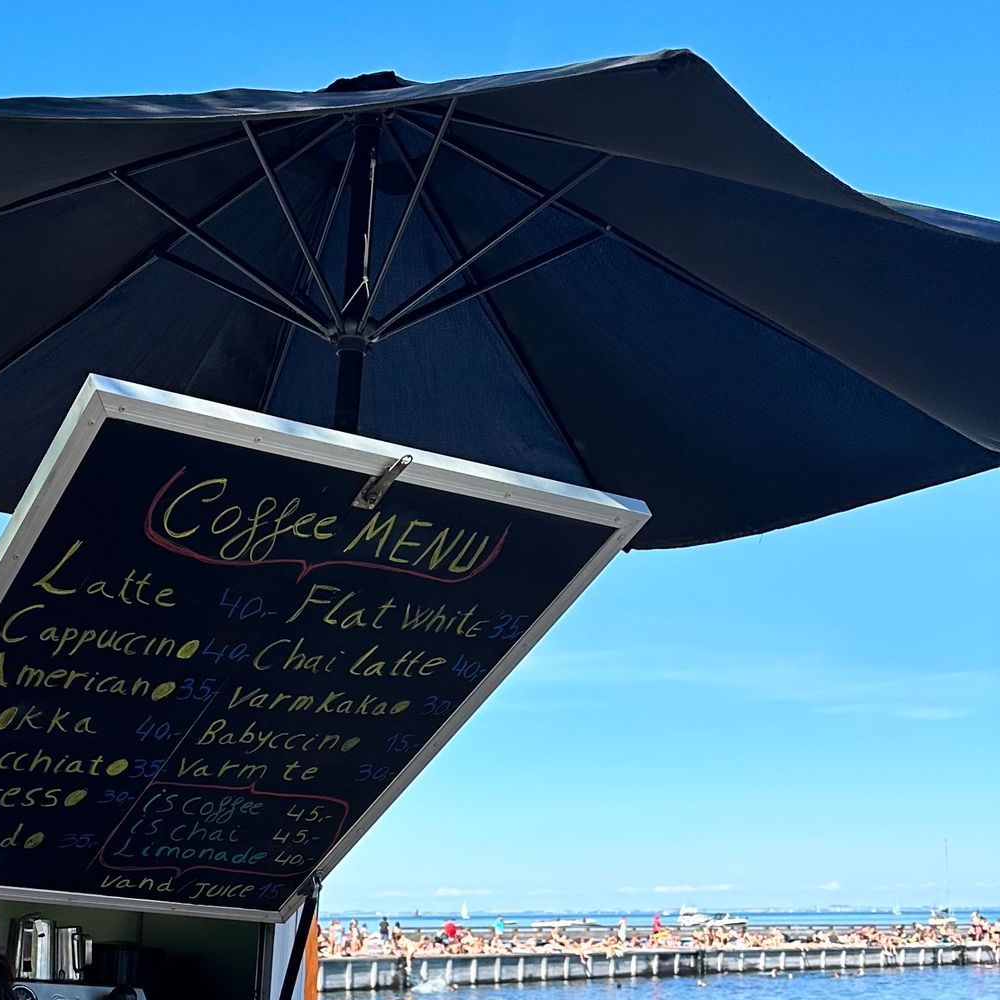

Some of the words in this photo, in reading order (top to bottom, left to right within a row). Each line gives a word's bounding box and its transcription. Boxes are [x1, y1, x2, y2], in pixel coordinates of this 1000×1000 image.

[164, 478, 336, 562] Coffee
[344, 511, 490, 573] MENU
[32, 540, 176, 606] Latte
[286, 584, 396, 630] Flat
[0, 604, 200, 659] Cappuccino
[253, 639, 345, 673] Chai
[197, 718, 361, 755] Babyccino
[177, 757, 268, 781] Varm
[283, 759, 319, 782] te
[182, 795, 266, 824] Coffee
[113, 837, 269, 866] Limonade
